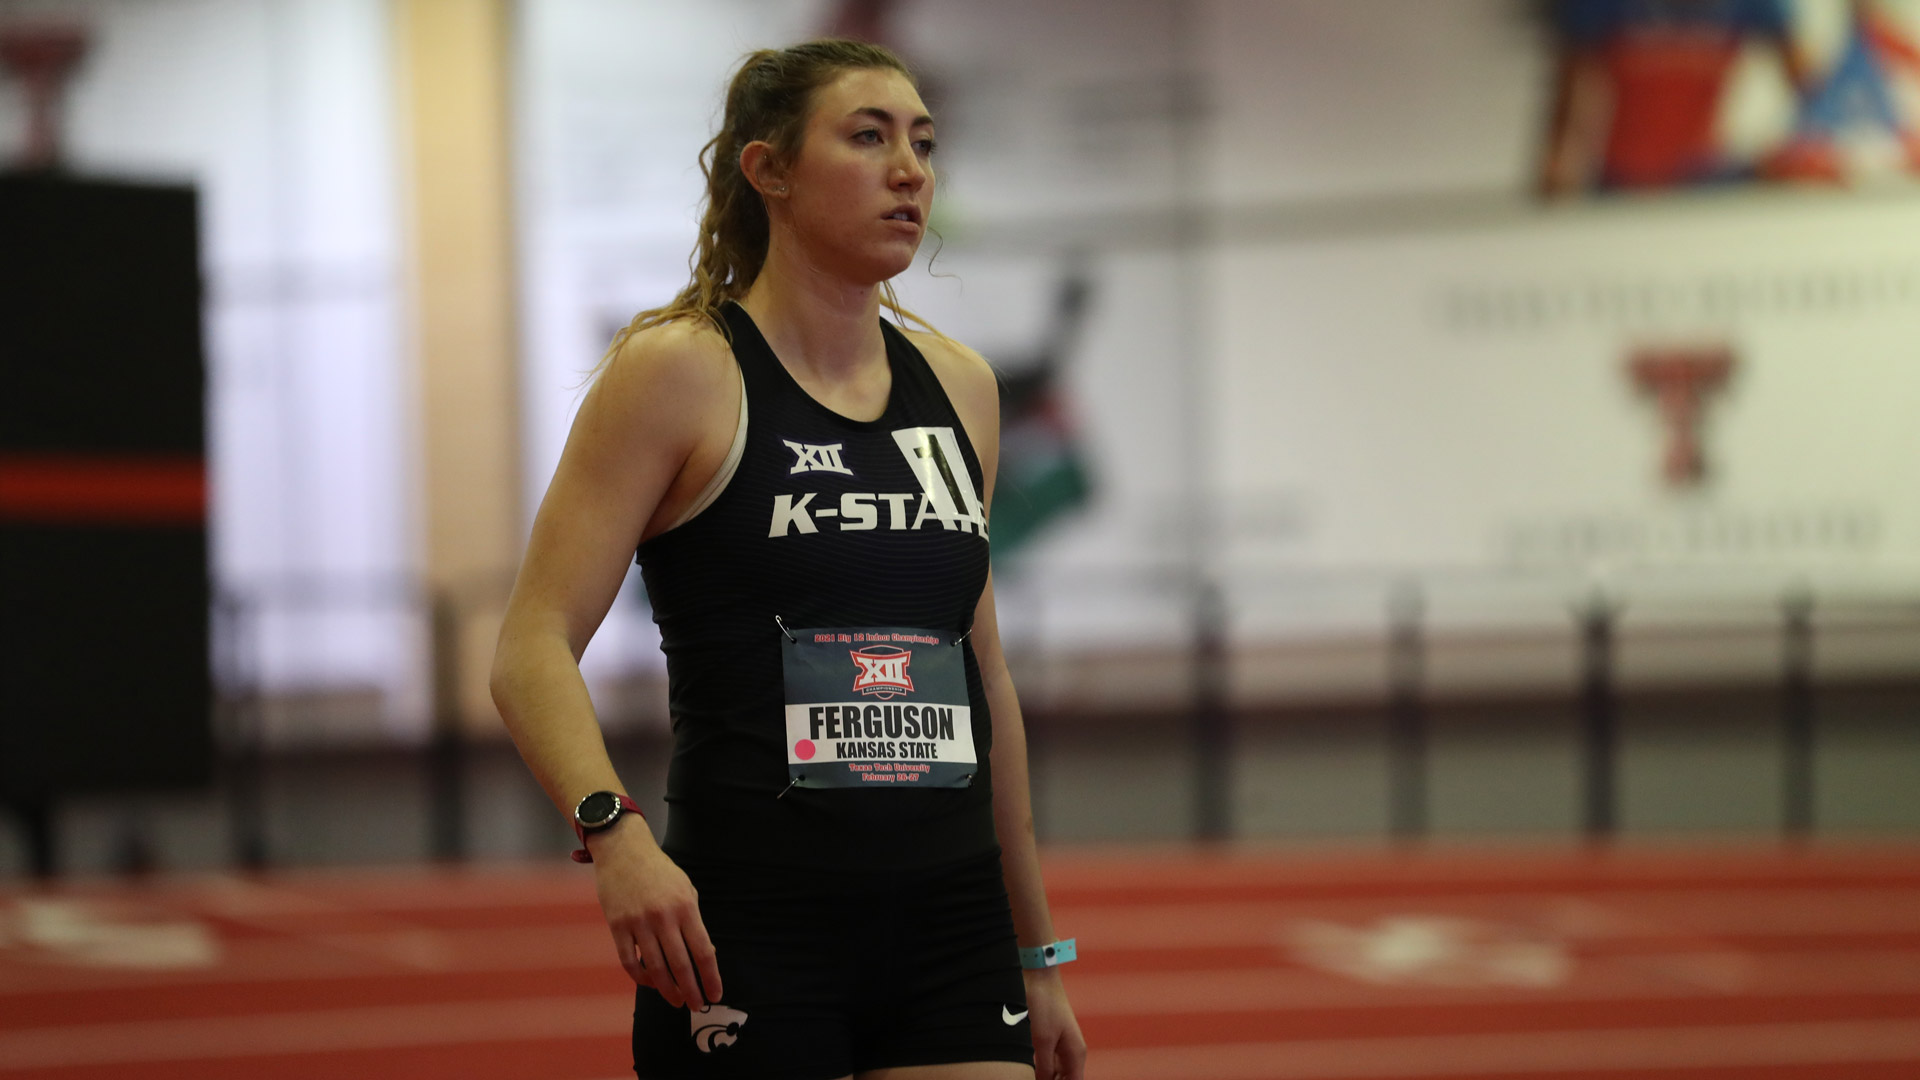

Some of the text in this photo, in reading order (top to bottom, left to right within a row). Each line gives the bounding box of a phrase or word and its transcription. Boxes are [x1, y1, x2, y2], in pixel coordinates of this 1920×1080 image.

[782, 439, 854, 476] XII
[768, 492, 989, 543] K-STA
[815, 633, 939, 645] 2021 Big 12 Indoor Championships
[856, 656, 910, 686] XII
[809, 704, 955, 740] FERGUSON
[836, 741, 938, 759] KANSAS STATE
[849, 763, 930, 773] Texas Tech University
[862, 773, 895, 782] February
